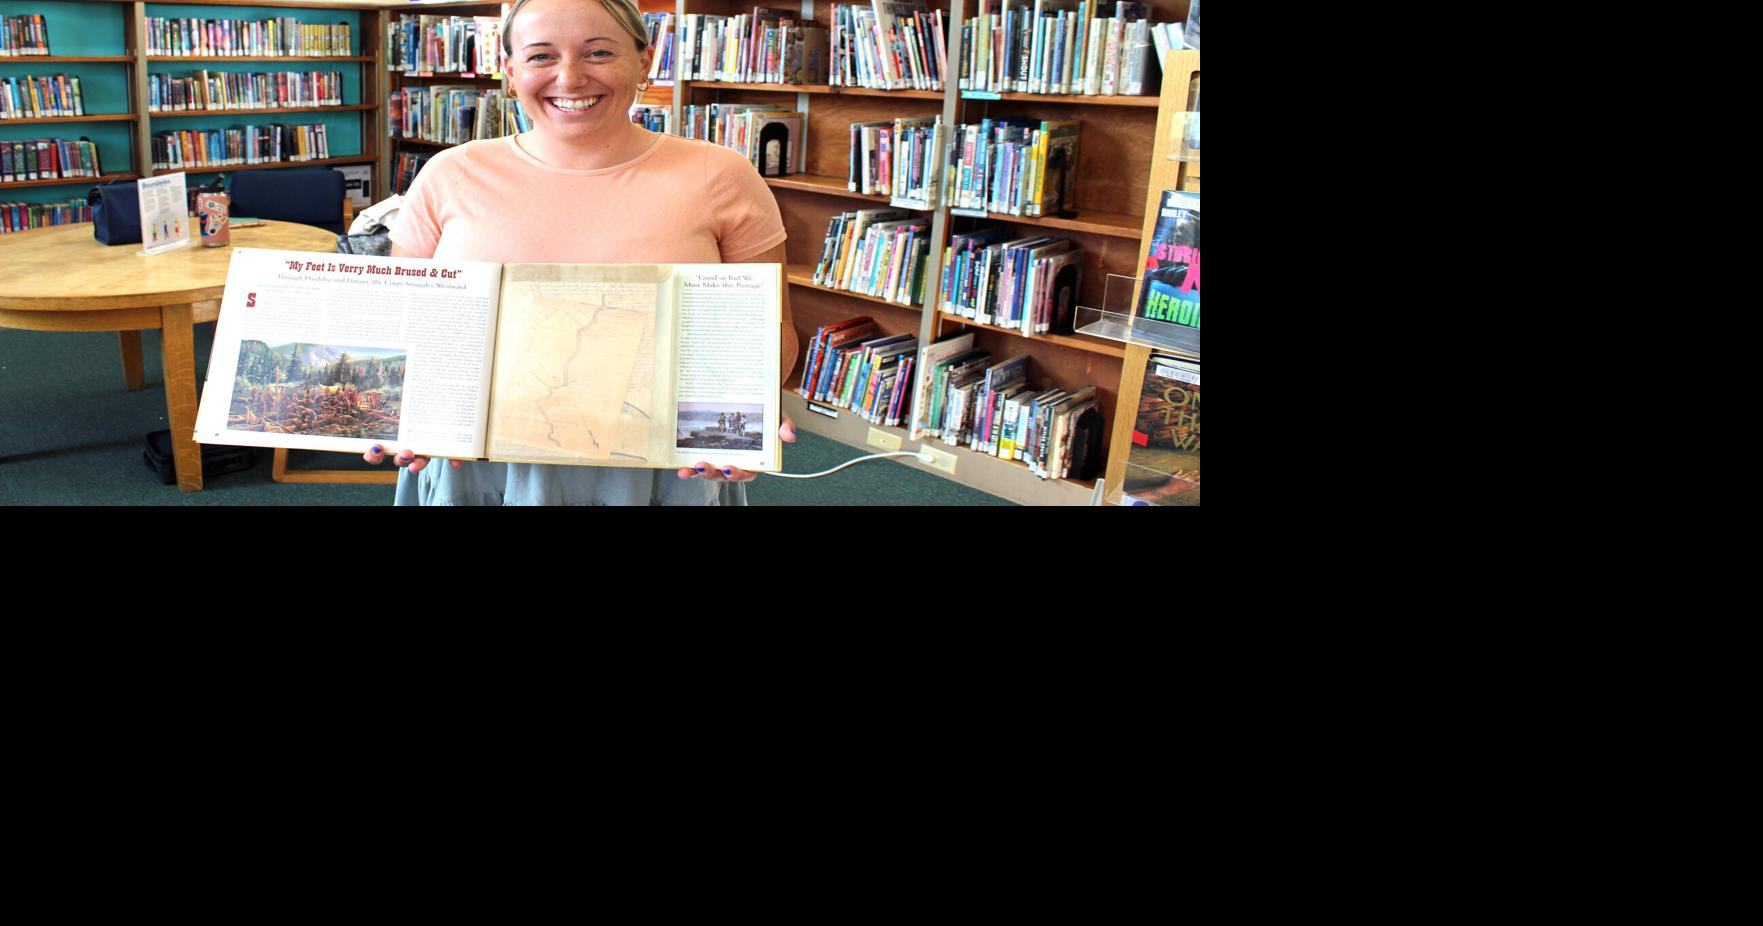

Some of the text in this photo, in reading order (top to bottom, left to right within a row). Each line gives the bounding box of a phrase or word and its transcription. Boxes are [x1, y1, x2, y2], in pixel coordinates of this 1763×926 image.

[305, 261, 325, 272] Feet
[327, 262, 336, 272] Is
[338, 263, 364, 276] Verry
[366, 264, 392, 275] Much
[394, 266, 427, 277] Brused
[429, 268, 438, 278] &
[246, 292, 257, 308] S
[1145, 289, 1200, 329] HEROI
[1162, 405, 1200, 432] TH
